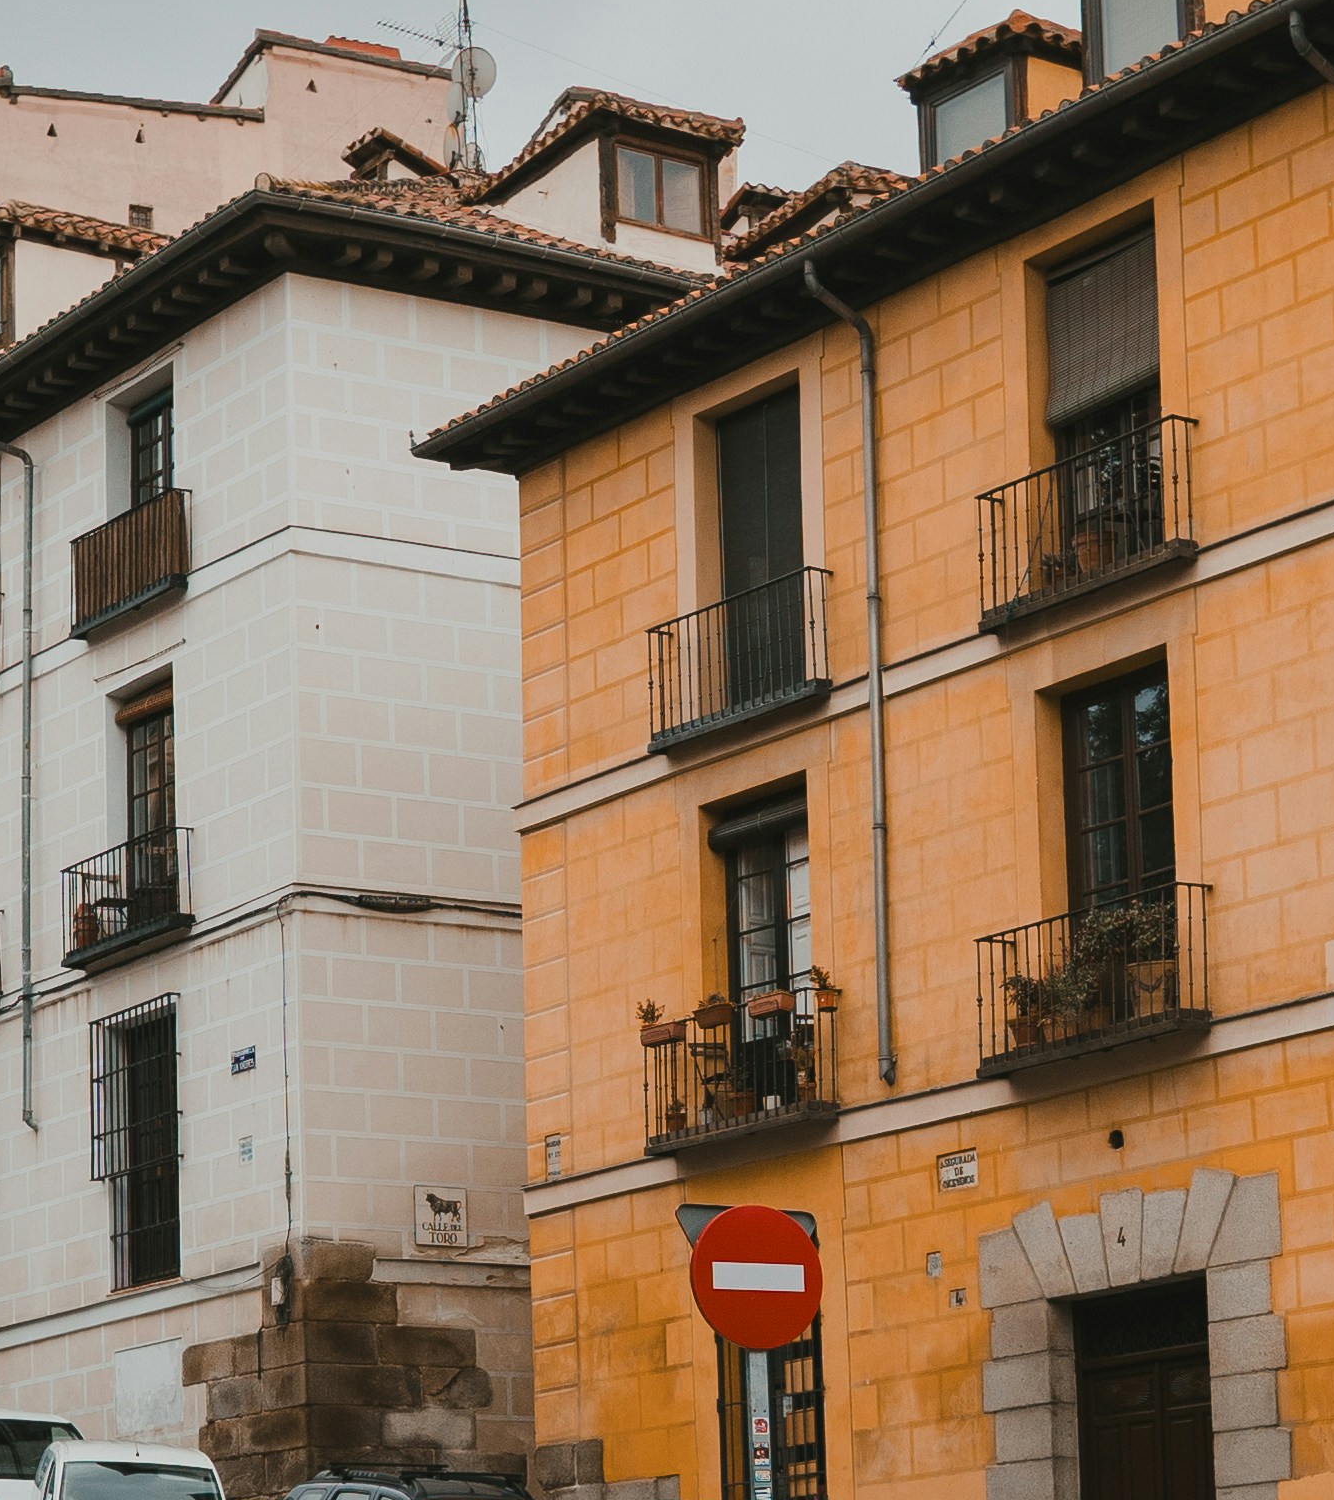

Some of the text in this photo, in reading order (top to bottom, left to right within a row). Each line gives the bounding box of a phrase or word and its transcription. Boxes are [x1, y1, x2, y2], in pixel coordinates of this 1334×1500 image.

[422, 1222, 450, 1232] CALLE
[429, 1231, 458, 1245] TORO
[1117, 1226, 1127, 1247] 4
